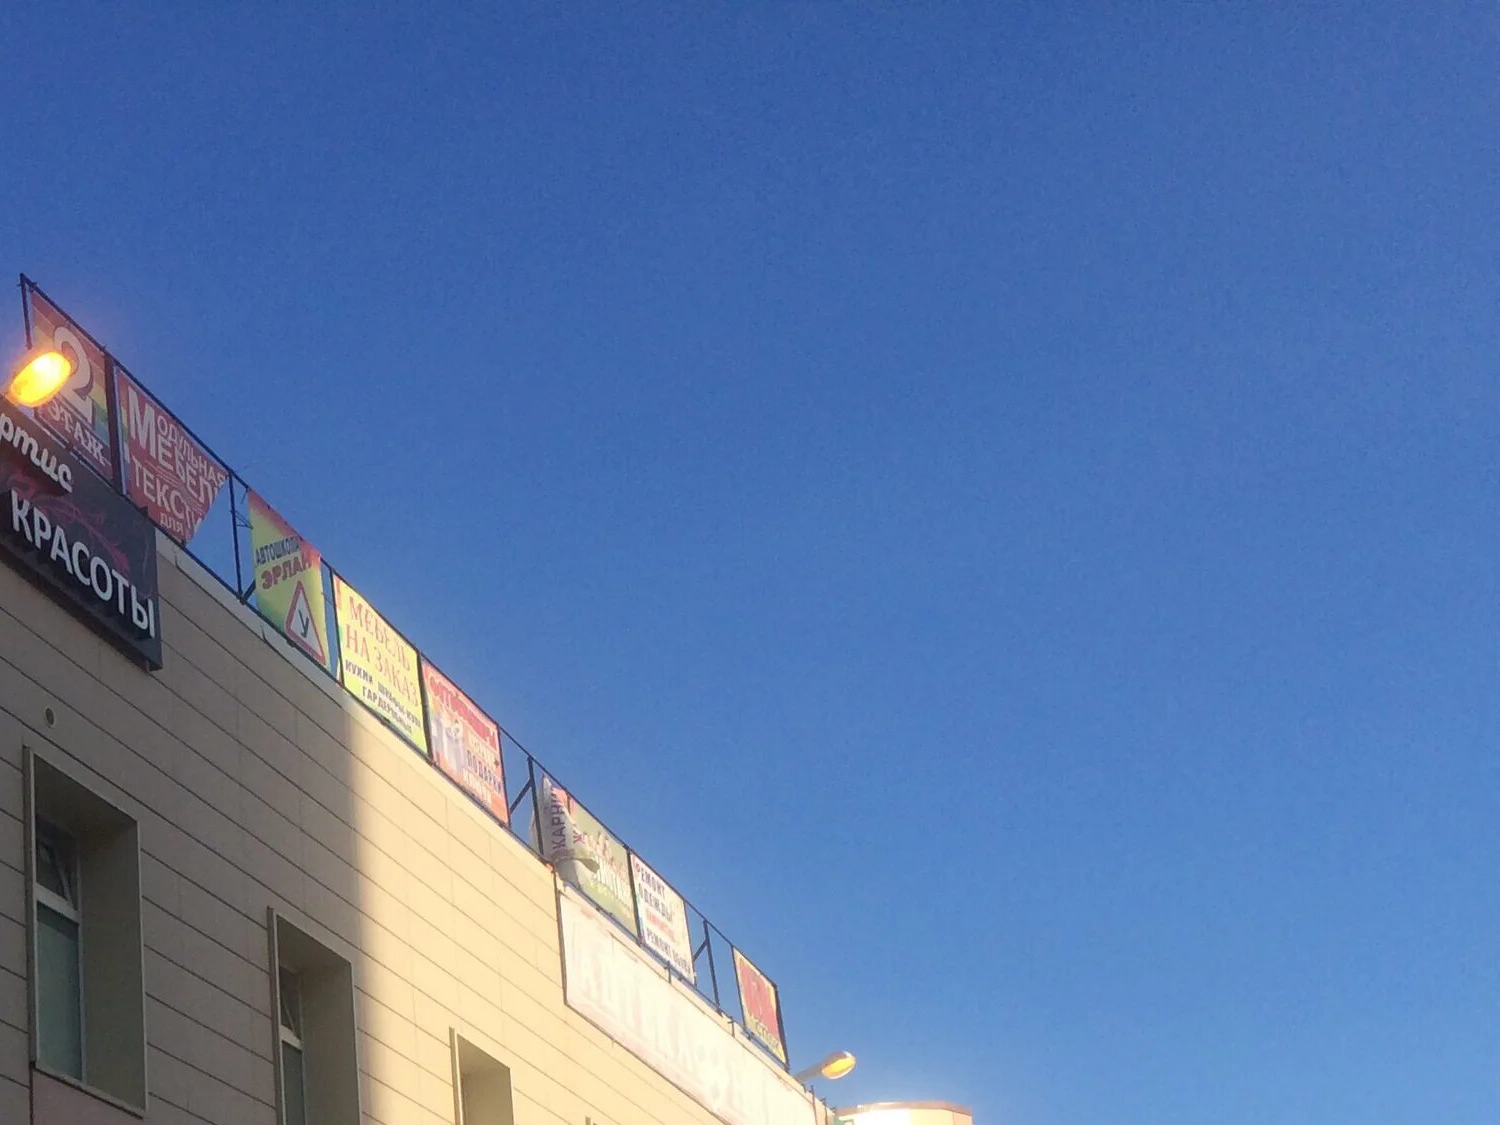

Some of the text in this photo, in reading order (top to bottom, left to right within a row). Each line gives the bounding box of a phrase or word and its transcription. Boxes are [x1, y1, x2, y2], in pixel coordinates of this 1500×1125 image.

[11, 489, 156, 639] КРАСОТЫ
[345, 623, 419, 708] НА ЗАКАЗ
[348, 595, 411, 672] МЕБЕЛЬ
